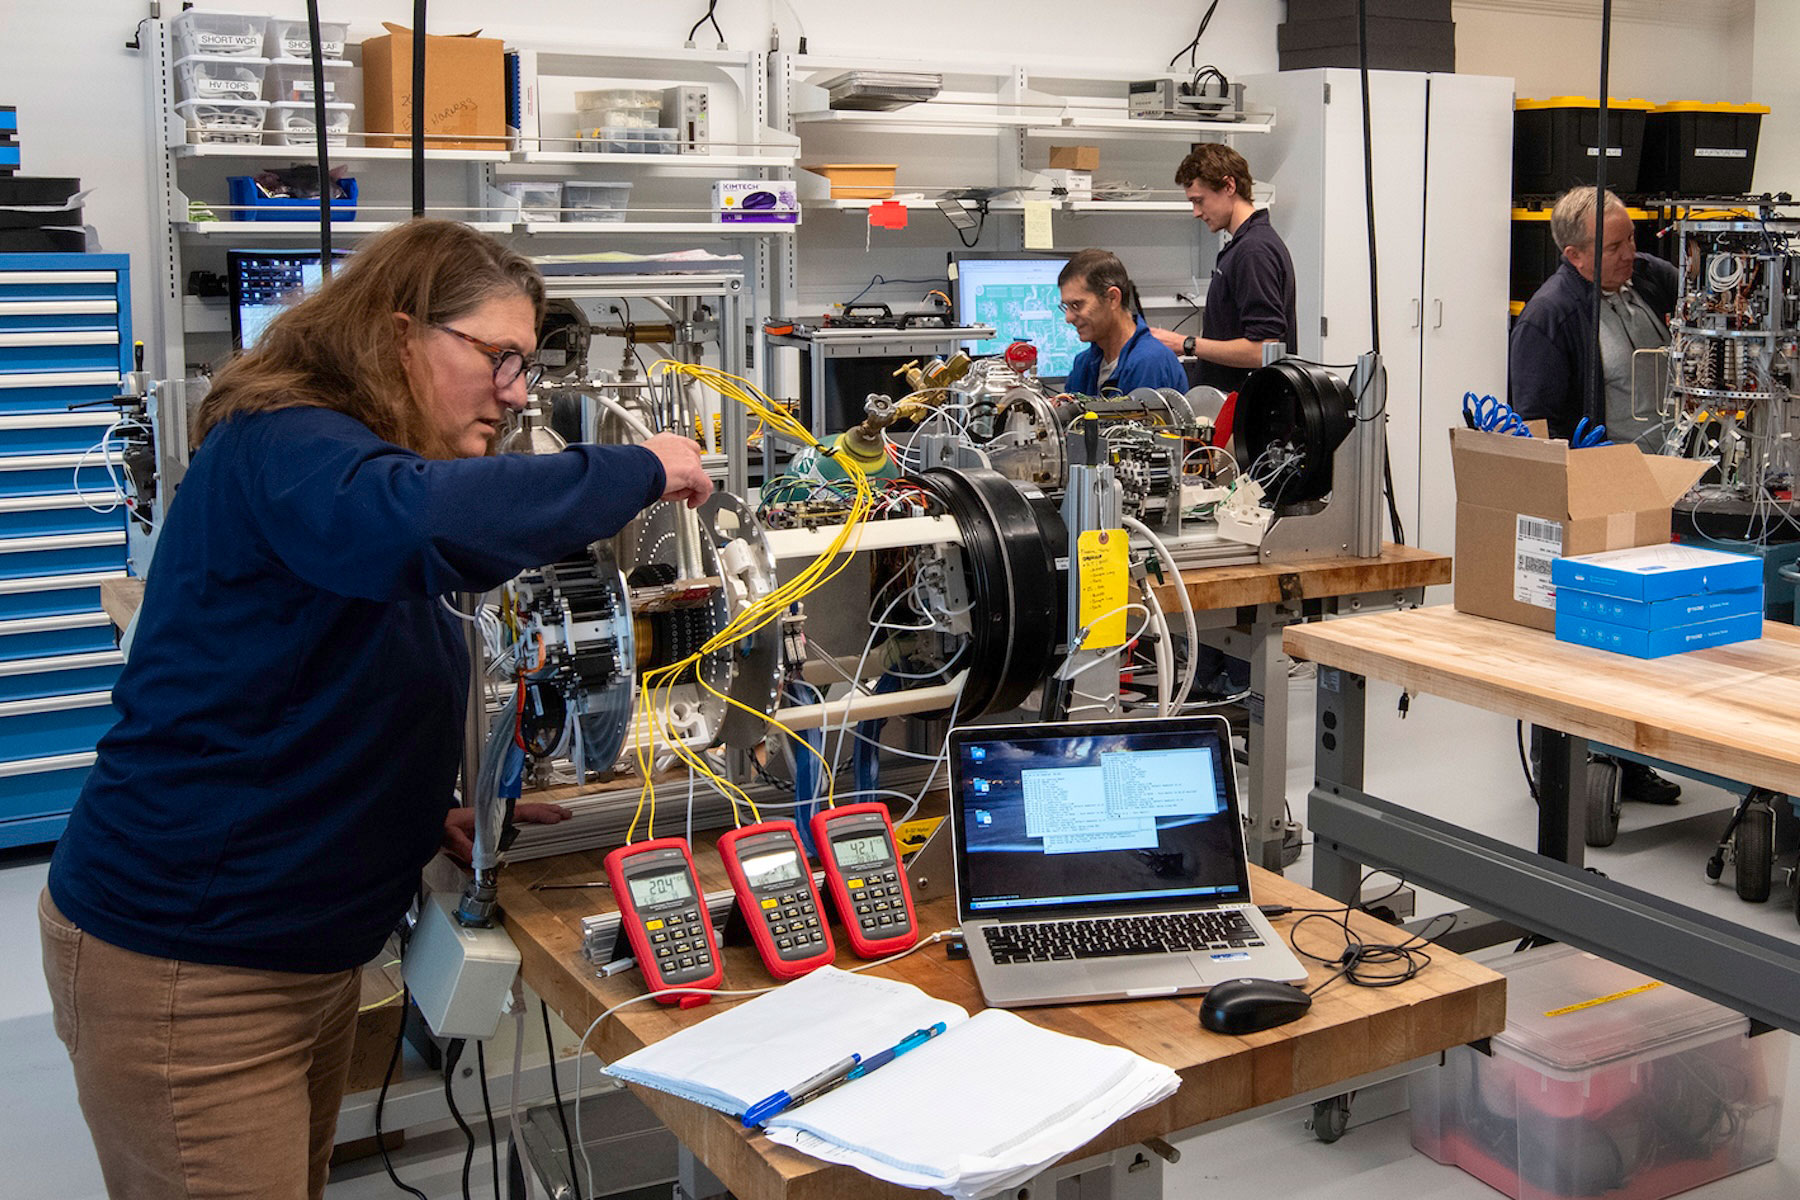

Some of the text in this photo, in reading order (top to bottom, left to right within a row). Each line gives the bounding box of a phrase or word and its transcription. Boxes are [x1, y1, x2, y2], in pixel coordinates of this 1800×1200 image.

[201, 35, 257, 45] SHORT WCR
[288, 41, 313, 49] SHOR
[209, 81, 250, 90] HV TOPS
